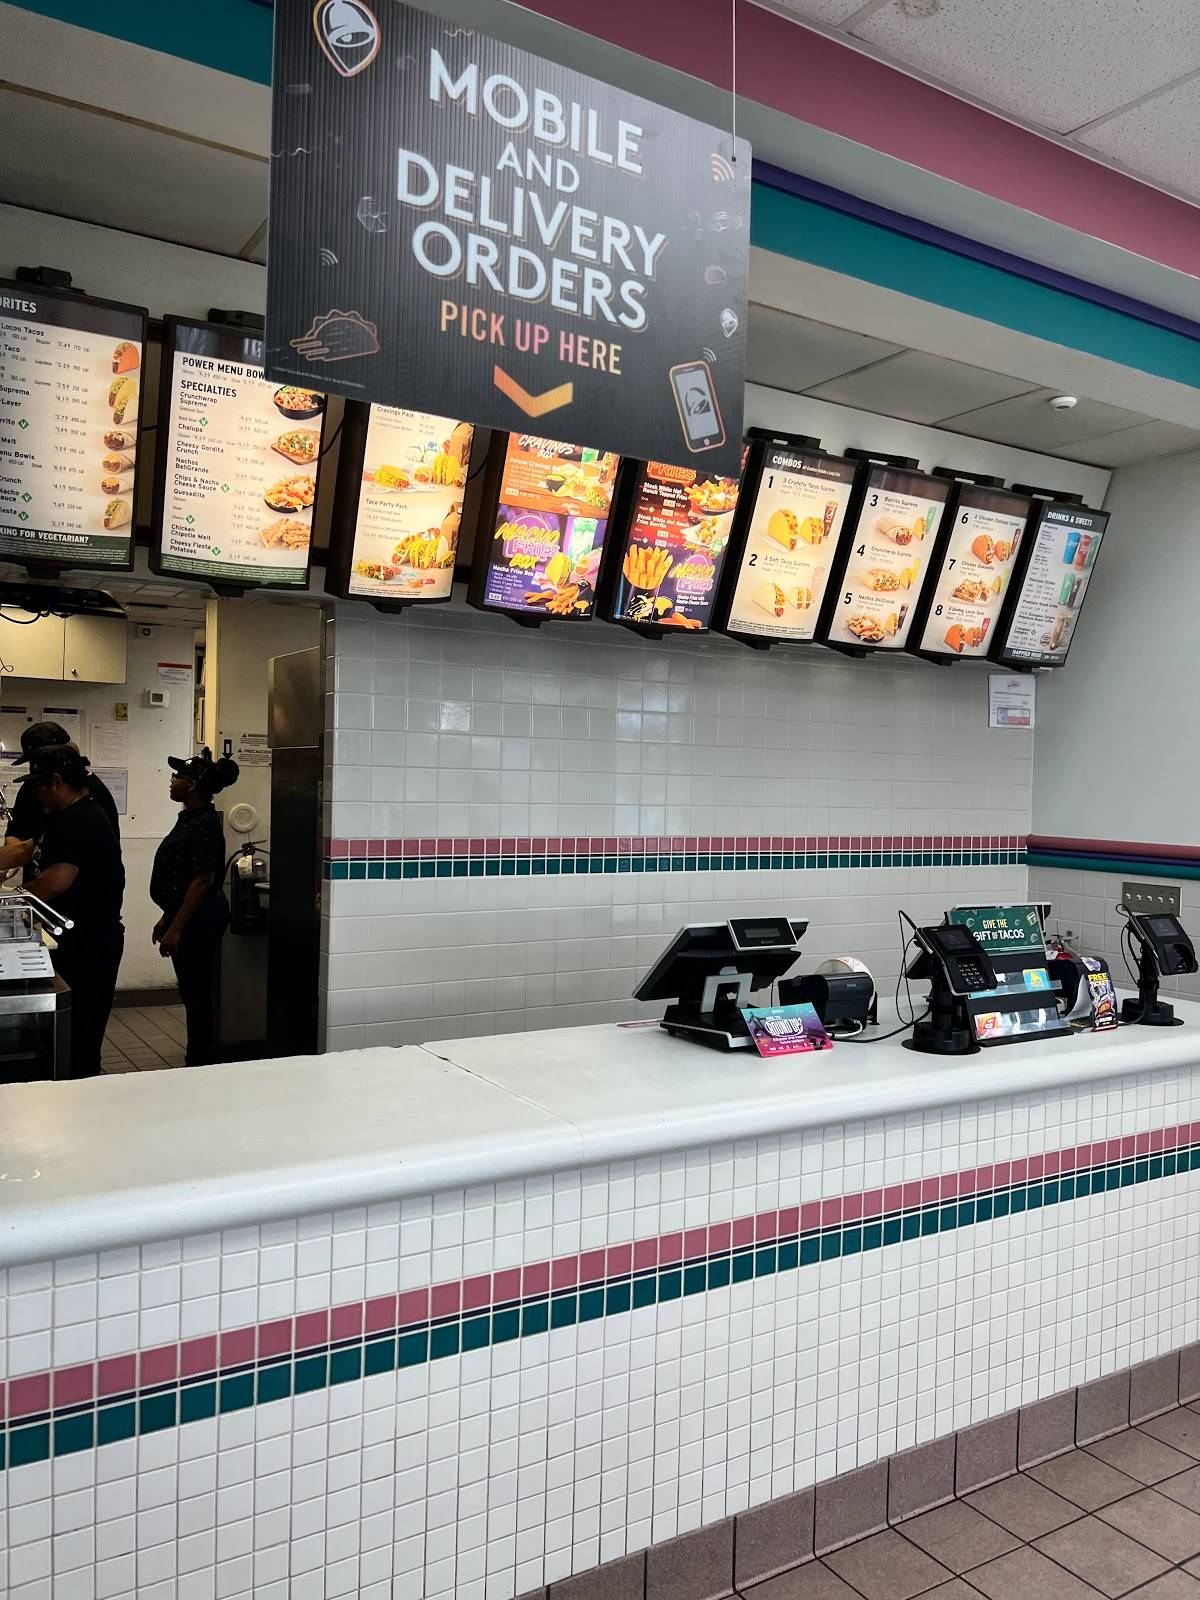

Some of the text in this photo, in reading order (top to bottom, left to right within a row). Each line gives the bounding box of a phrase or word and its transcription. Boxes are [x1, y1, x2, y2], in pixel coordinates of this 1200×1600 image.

[430, 48, 643, 174] MOBILE
[497, 141, 580, 193] AND
[398, 148, 666, 277] DELIVERY
[412, 221, 648, 329] ORDERS
[24, 327, 44, 336] Tacos
[441, 300, 622, 375] PICK UP HERE
[4, 343, 21, 353] Taco
[182, 356, 214, 371] POWER
[217, 363, 243, 376] MENU
[180, 379, 237, 398] SPECIALTIES
[180, 391, 218, 403] Crunchwrap
[180, 397, 208, 408] Supreme
[377, 406, 401, 416] Cravings
[178, 423, 203, 433] Chalupa
[176, 440, 199, 449] Cheesy
[201, 444, 224, 453] Gordita
[176, 446, 199, 455] Crunch
[518, 434, 576, 455] CRAVINGS
[15, 451, 35, 460] Bowls
[176, 457, 199, 466] Nachos
[772, 456, 802, 469] COMBOS
[648, 460, 697, 481] FRIES
[174, 473, 192, 482] Chips
[200, 478, 219, 486] Nacho
[768, 476, 774, 488] 1
[174, 480, 196, 488] Cheese
[198, 483, 217, 492] Sauce
[173, 488, 205, 498] Quesadilla
[870, 494, 878, 507] 3
[961, 513, 969, 524] 6
[1047, 511, 1070, 521] DRINKS
[171, 524, 196, 532] Chicken
[494, 522, 560, 545] NACHO
[20, 529, 36, 539] FOR
[38, 531, 89, 544] VEGETARIAN?
[170, 530, 196, 539] Chipotle
[170, 539, 191, 547] Cheesy
[512, 539, 560, 557] FRIES
[170, 545, 197, 554] Potatoes
[856, 544, 866, 556] 4
[509, 553, 540, 569] BOX
[748, 553, 758, 566] 2
[948, 558, 956, 570] 7
[492, 565, 509, 573] Nacho
[844, 592, 853, 605] 5
[935, 604, 943, 616] 8
[982, 918, 1009, 929] GIVE THE
[973, 928, 1025, 941] GIFT OF TACOS
[1087, 972, 1109, 982] FREE
